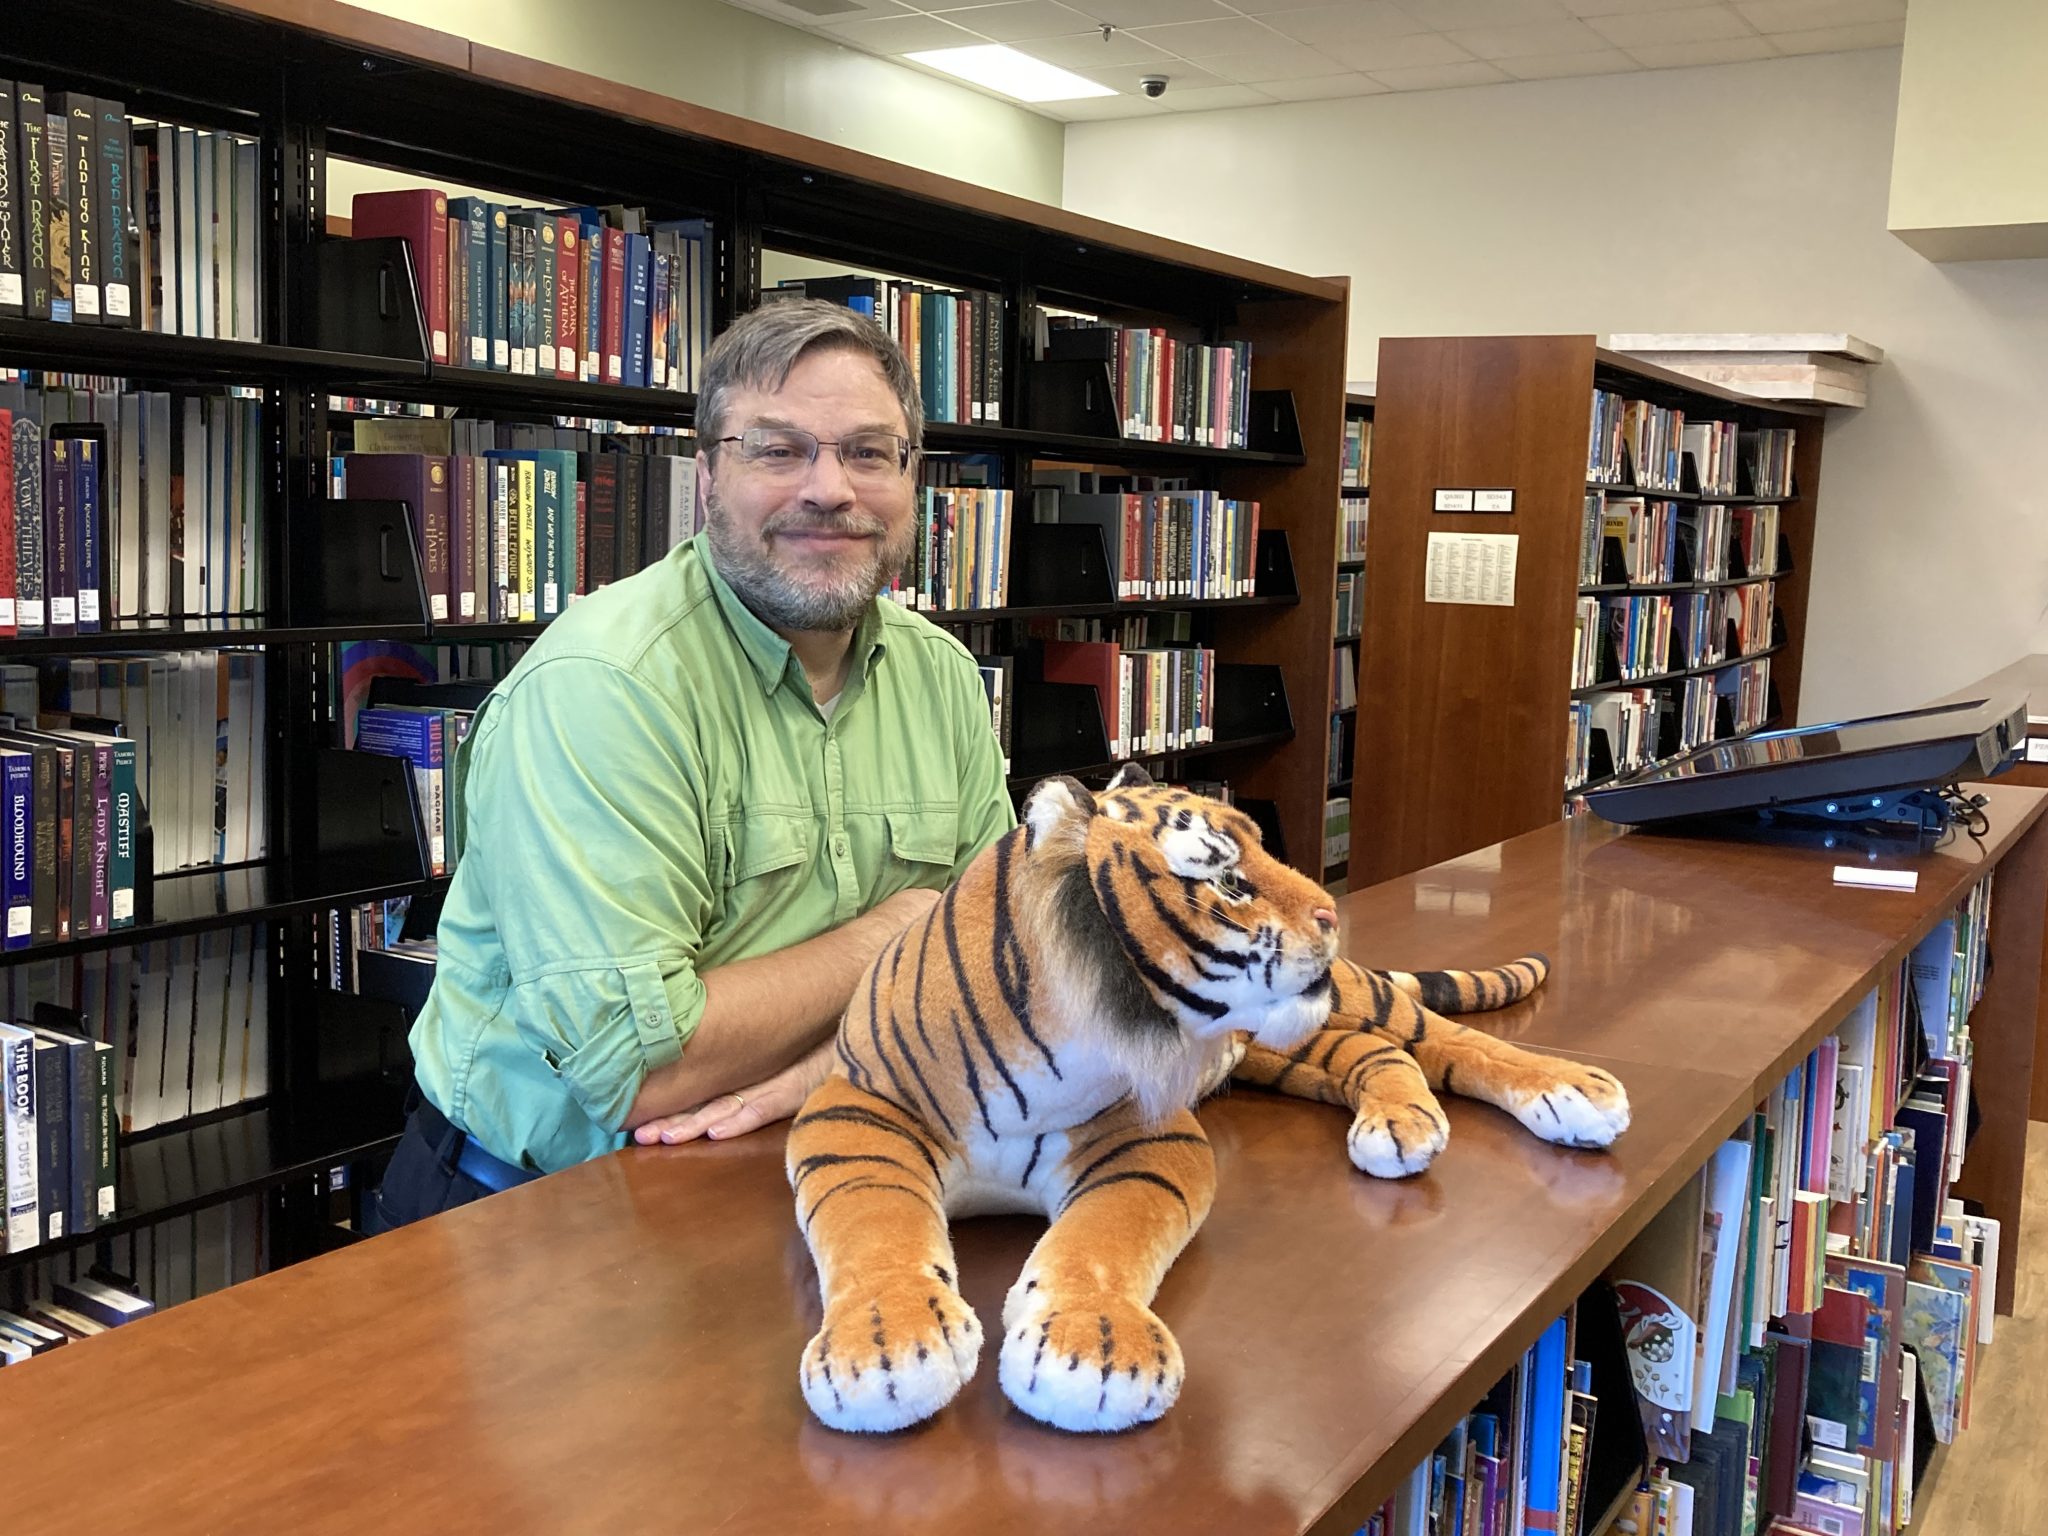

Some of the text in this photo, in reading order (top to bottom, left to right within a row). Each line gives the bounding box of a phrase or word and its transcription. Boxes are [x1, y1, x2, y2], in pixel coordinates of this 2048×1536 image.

[24, 122, 42, 134] THE
[79, 146, 91, 224] INDIGO
[111, 163, 123, 199] RED
[31, 199, 44, 268] DRAGON
[112, 206, 124, 280] DRAGON
[81, 229, 92, 283] KING
[542, 274, 554, 306] LOST
[559, 270, 571, 339] OF ATHENA
[568, 278, 578, 337] THE MARK
[542, 307, 554, 347] HERO
[993, 319, 1001, 352] NOW
[973, 354, 981, 400] DARKE
[20, 477, 32, 512] VOW
[682, 484, 690, 528] HARRY
[58, 506, 67, 542] KINGDOM
[83, 503, 93, 538] KINGDOM
[479, 513, 487, 568] JACKABY
[578, 514, 586, 548] HARRY
[21, 523, 33, 592] THIEVES
[58, 543, 67, 573] KEEPERS
[83, 539, 93, 568] KEEPERS
[426, 528, 439, 573] HADES
[438, 531, 448, 574] HOUSE
[508, 508, 518, 580] BELLE EPOQUE
[525, 576, 533, 594] SON
[113, 751, 135, 759] TAMORA
[430, 723, 442, 763] HOLES
[98, 751, 108, 779] PIERCE
[116, 792, 130, 858] MASTIFF
[434, 784, 442, 833] SACHAR
[14, 794, 25, 880] BLOODHOUND
[95, 796, 108, 898] LADY KNIGHT
[15, 1045, 28, 1071] THE
[15, 1074, 30, 1117] BOOK
[18, 1141, 31, 1178] DUST
